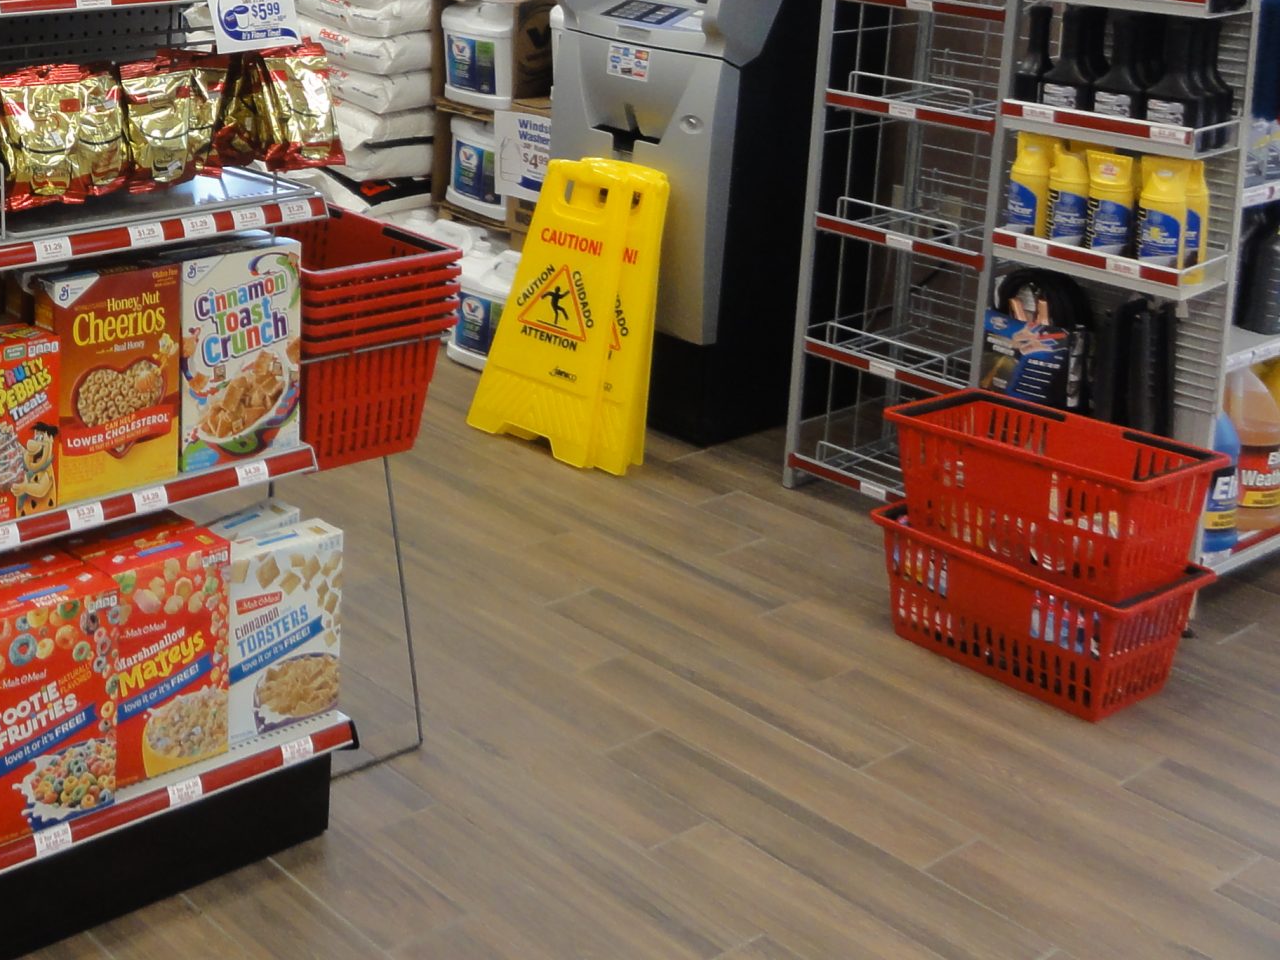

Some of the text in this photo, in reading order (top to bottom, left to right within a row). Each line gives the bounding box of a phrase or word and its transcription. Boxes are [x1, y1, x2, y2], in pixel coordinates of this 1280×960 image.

[540, 227, 603, 257] CAUTION!
[106, 290, 161, 313] Honey Nut
[516, 263, 557, 308] CAUTION
[572, 270, 595, 329] CUIDADO
[72, 307, 166, 347] Cheerios
[216, 296, 272, 336] Toast
[520, 324, 578, 352] ATTENTION
[9, 392, 48, 421] Treats
[104, 414, 136, 432] CAN HELP
[67, 433, 104, 449] LOWER
[105, 413, 169, 440] CHOLESTEROL
[115, 626, 186, 671] Marshmallow
[237, 604, 309, 658] TOASTERS
[119, 630, 205, 698] Mateys
[123, 663, 199, 713] love it or it's FREE!
[4, 711, 86, 766] love it or it's FREE!
